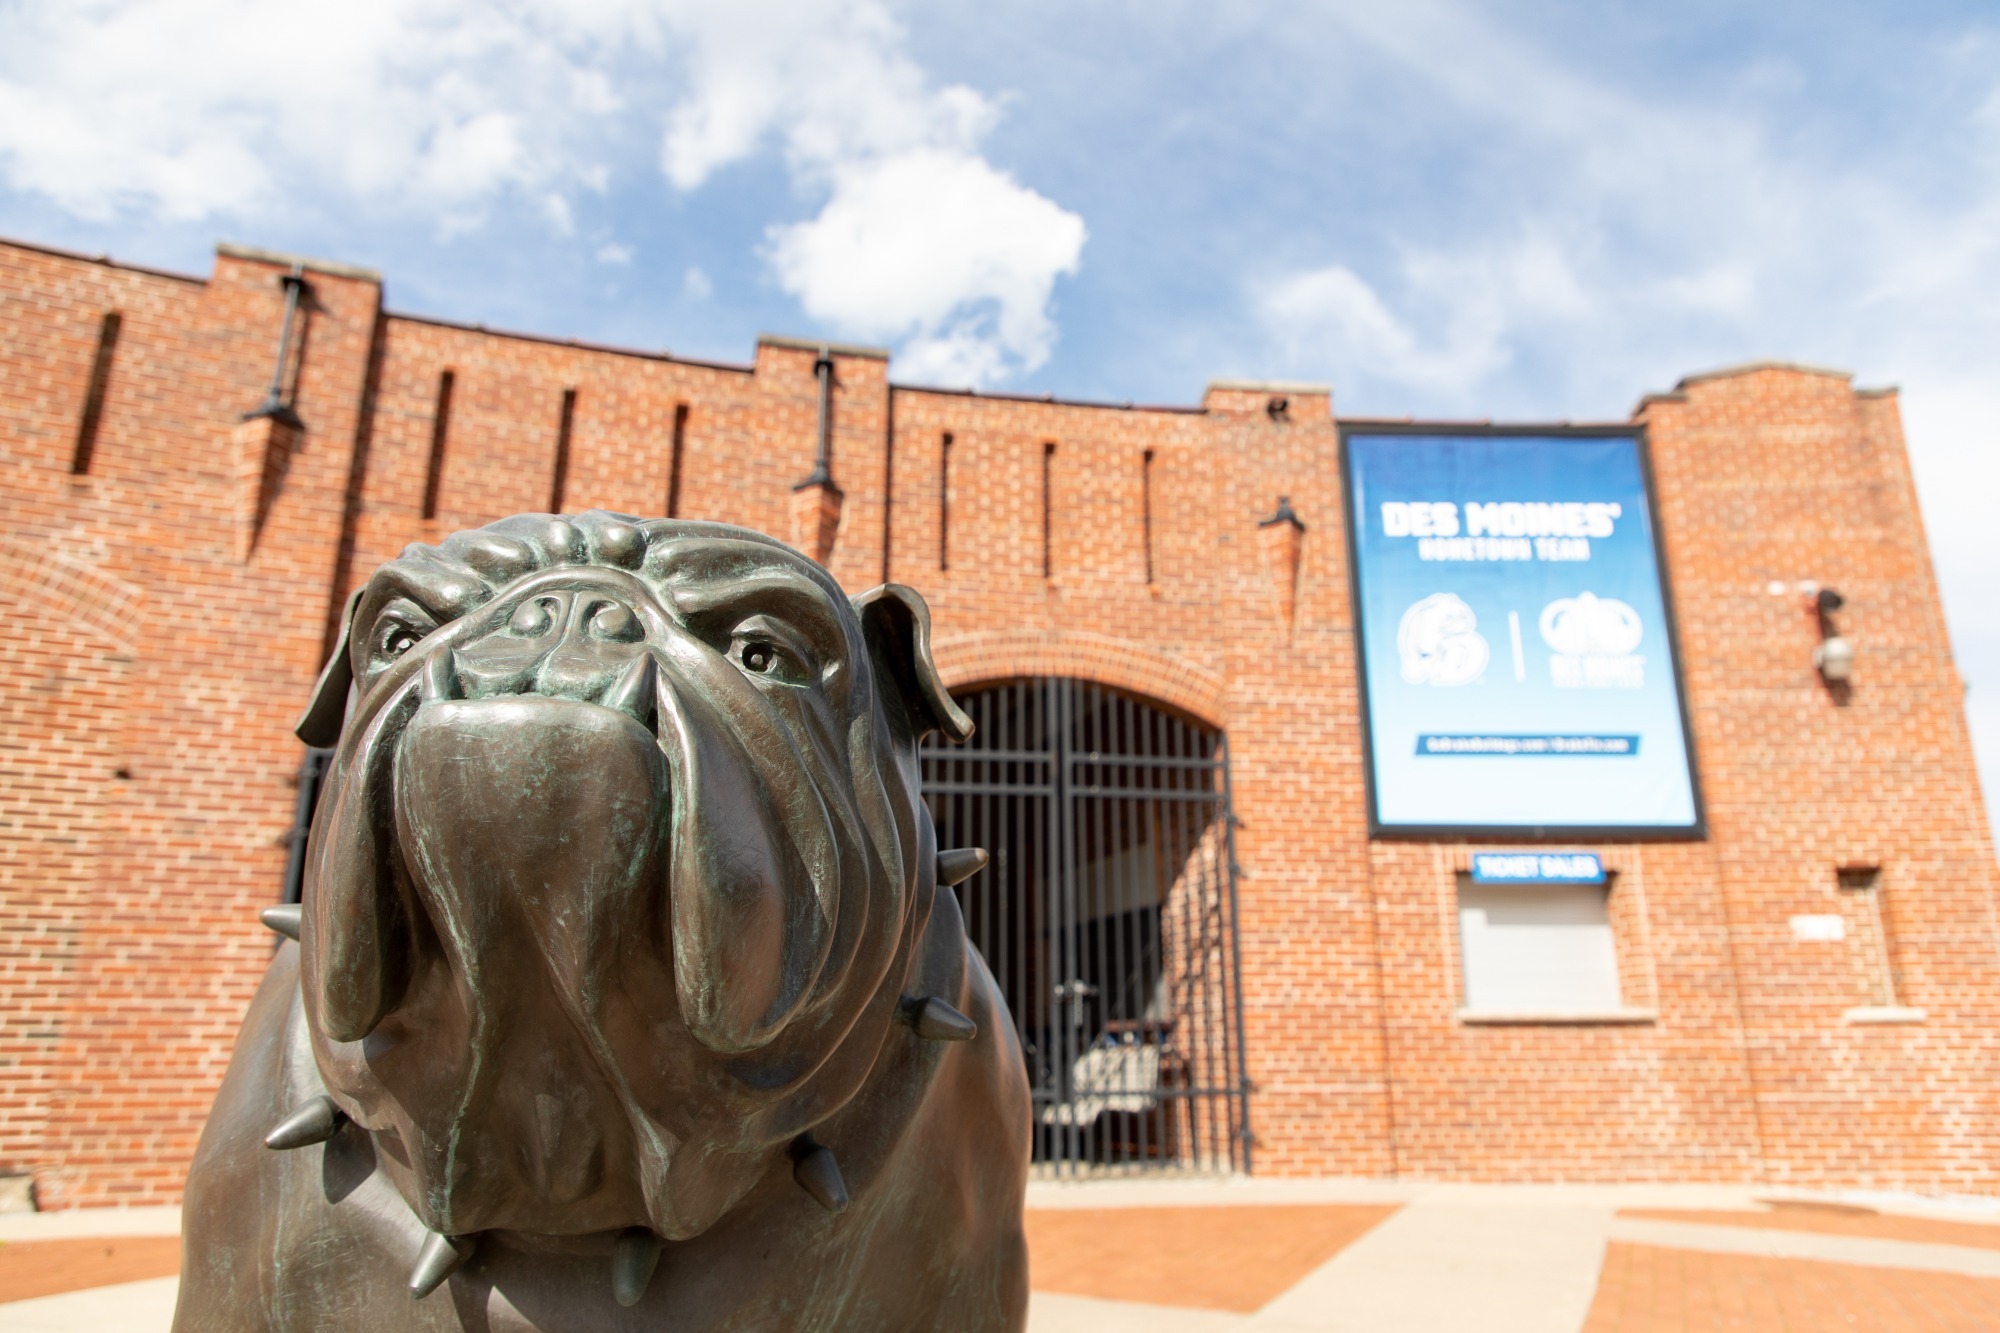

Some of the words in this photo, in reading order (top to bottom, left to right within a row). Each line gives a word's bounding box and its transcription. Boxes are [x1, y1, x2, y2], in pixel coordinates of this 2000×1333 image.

[1381, 502, 1460, 537] DES
[1535, 538, 1591, 561] TEAM
[1477, 855, 1539, 878] TICKET
[1540, 856, 1599, 878] SALES
